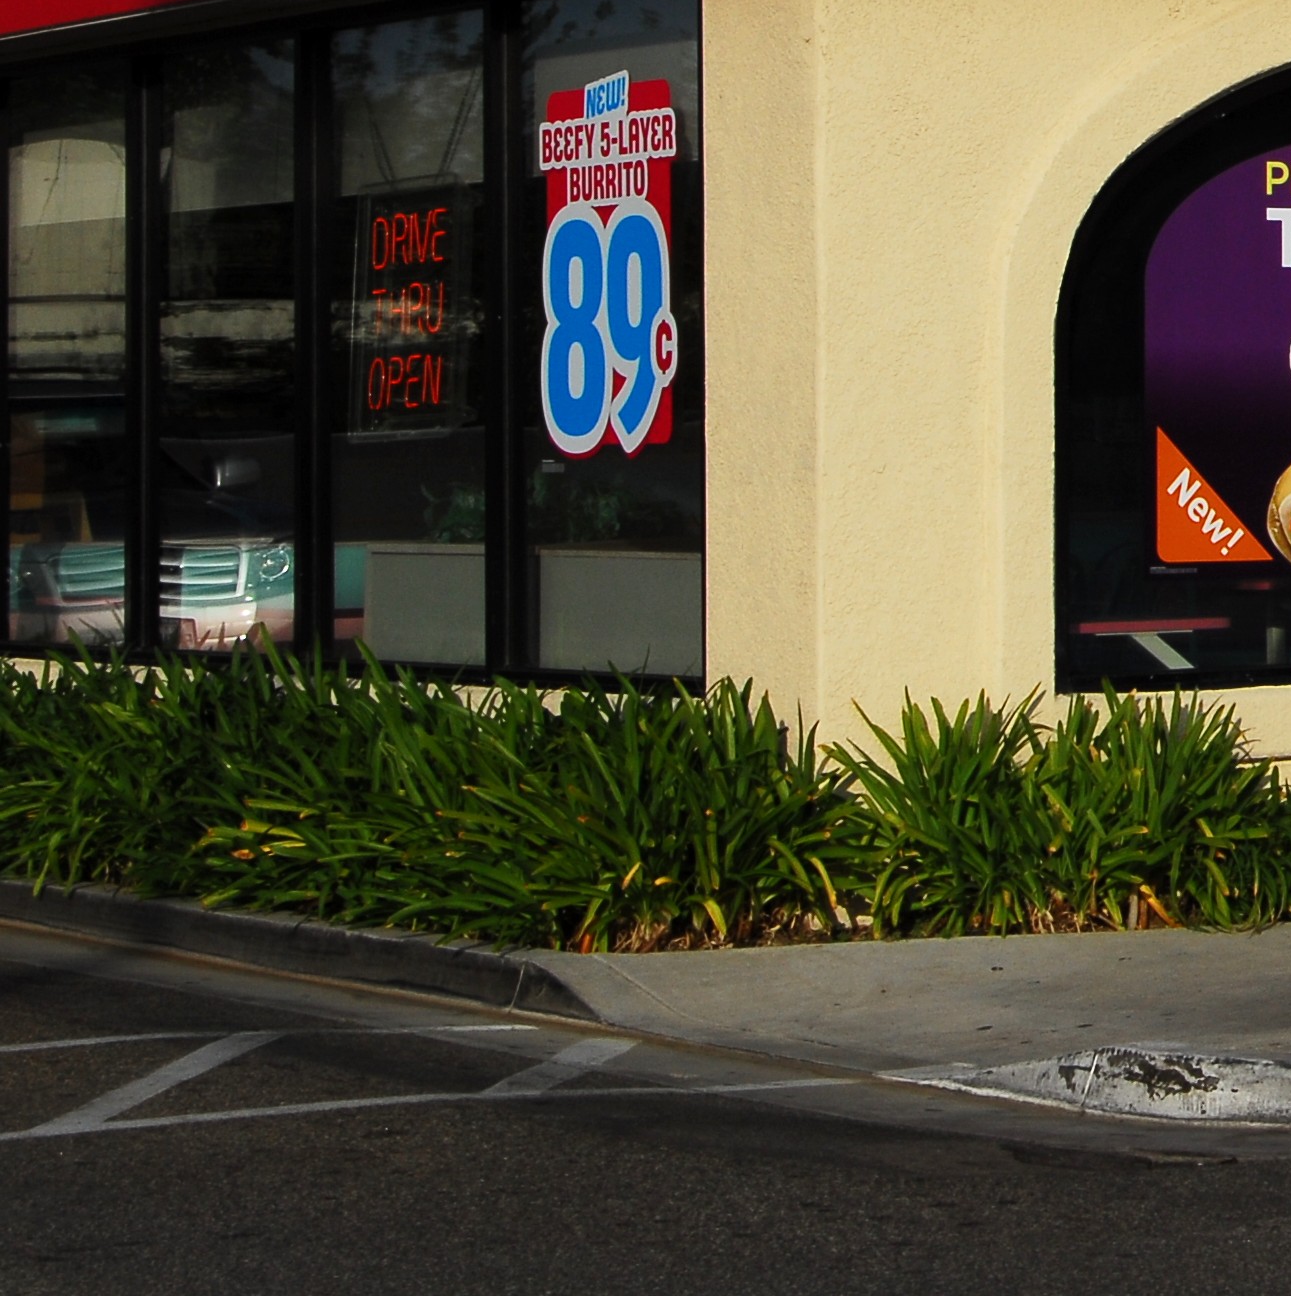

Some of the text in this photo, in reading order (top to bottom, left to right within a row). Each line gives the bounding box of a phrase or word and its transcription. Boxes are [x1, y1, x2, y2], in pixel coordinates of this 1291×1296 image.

[586, 76, 626, 119] NEW!
[542, 114, 674, 164] BEEFY 5-LAYER
[569, 160, 646, 202] BURRITO
[371, 207, 448, 271] DRIVE
[372, 281, 445, 336] THRU
[367, 353, 443, 411] OPEN
[1166, 467, 1245, 556] New!
